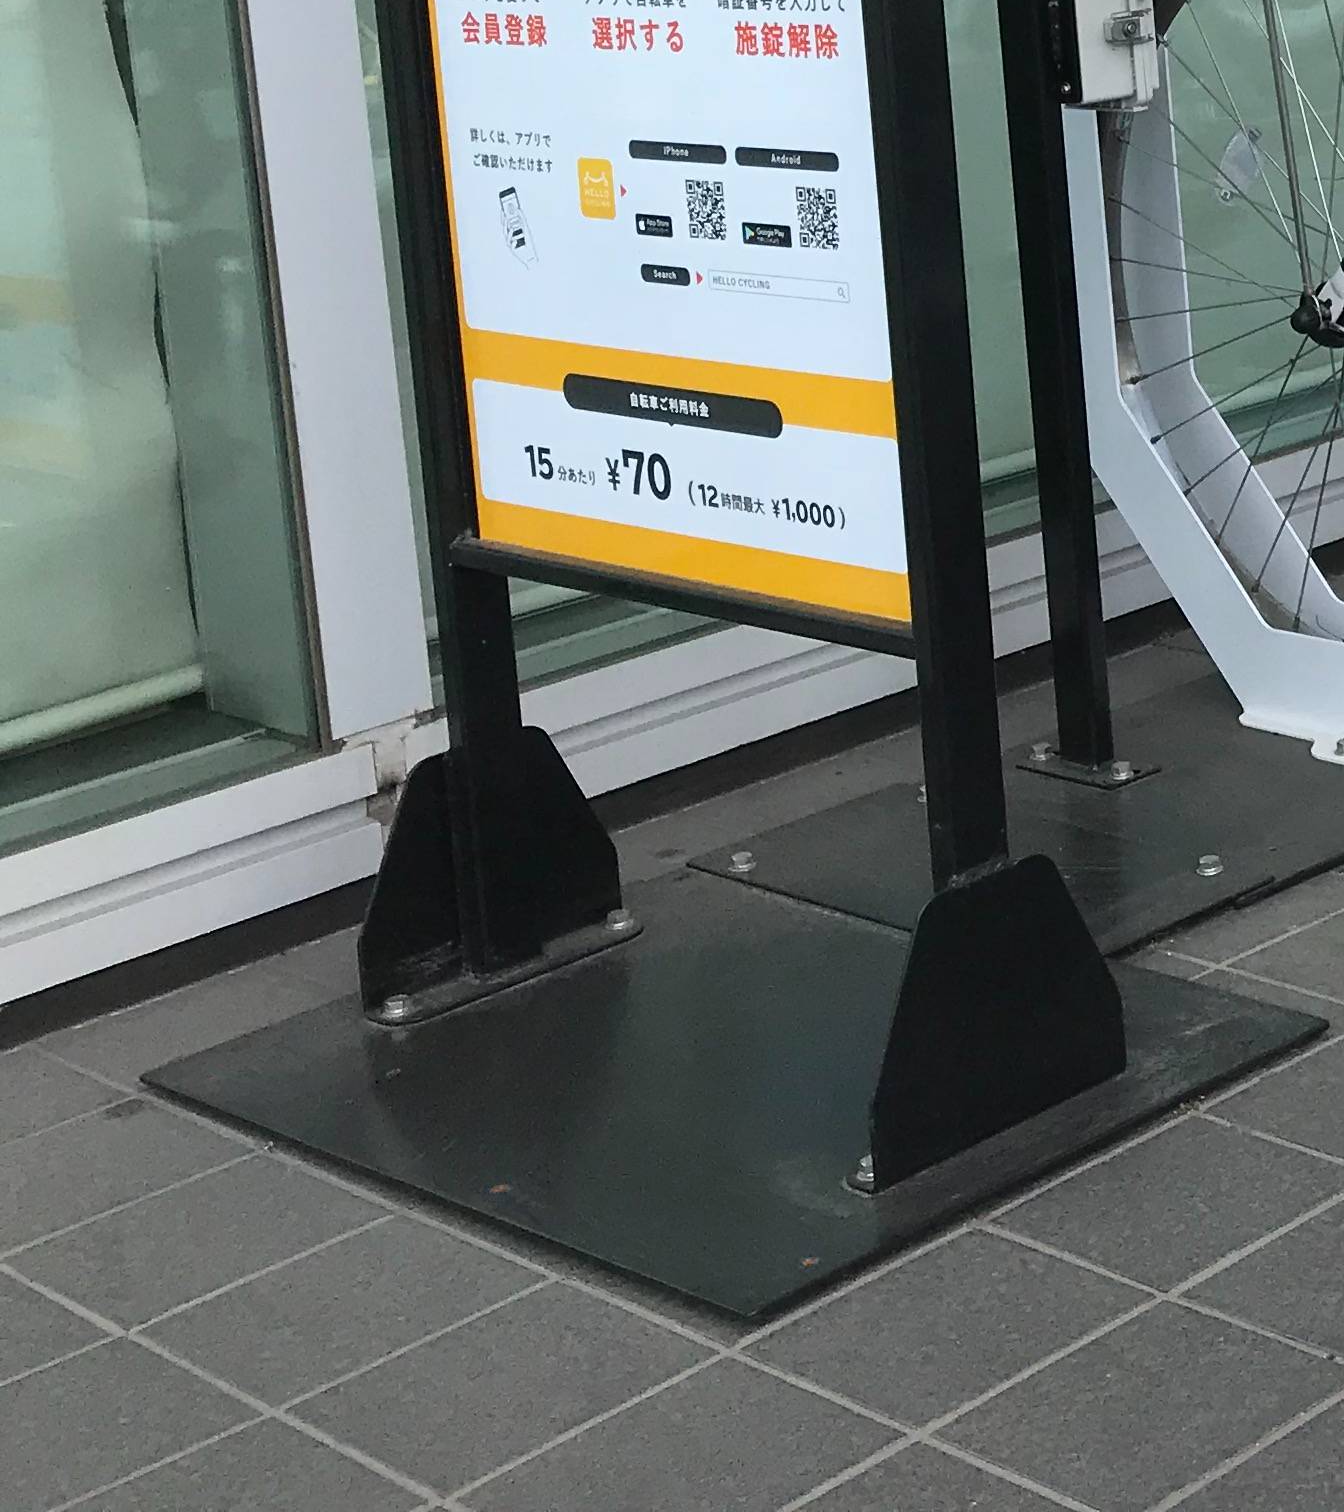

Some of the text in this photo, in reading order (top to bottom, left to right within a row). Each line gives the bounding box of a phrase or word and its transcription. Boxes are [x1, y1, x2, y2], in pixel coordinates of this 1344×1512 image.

[461, 11, 548, 48] 会員登録
[591, 16, 684, 54] 選択する
[734, 21, 841, 60] 施錠解除
[663, 145, 689, 157] iPhone
[770, 152, 801, 166] Android
[652, 268, 677, 281] Search
[712, 275, 771, 290] HELLO CYCLING
[629, 392, 711, 419] 自転車ご利用料金
